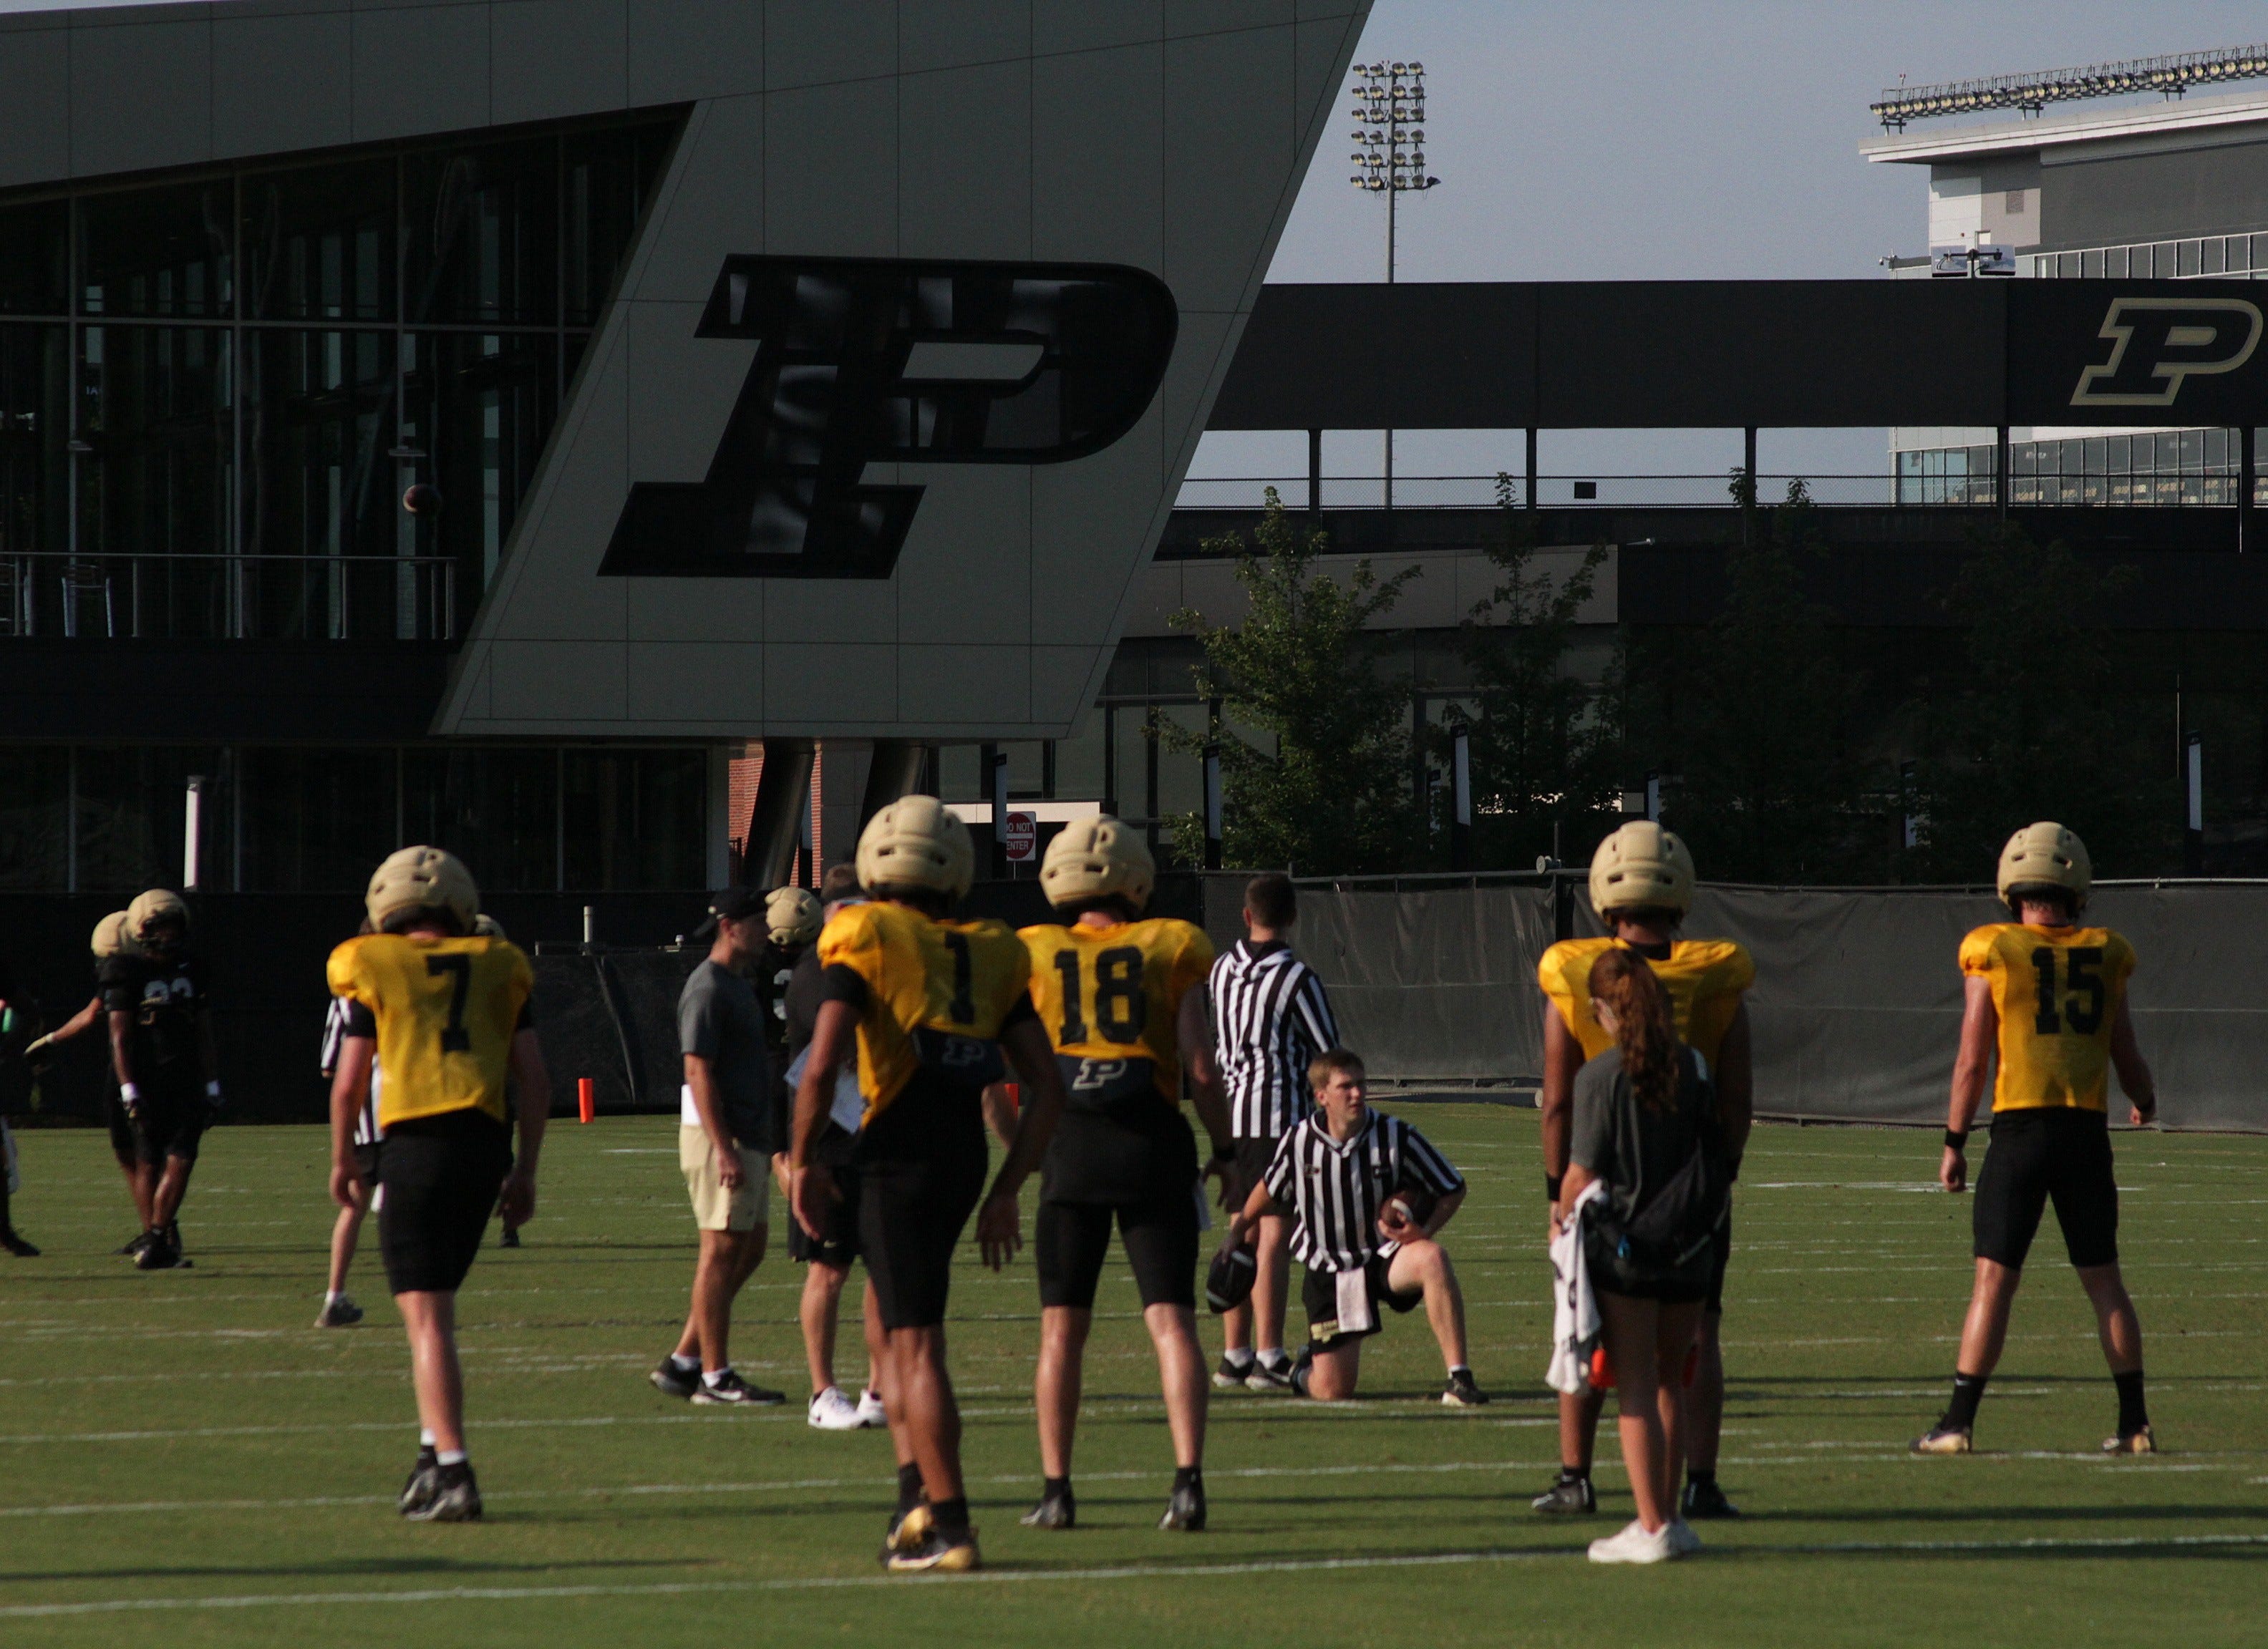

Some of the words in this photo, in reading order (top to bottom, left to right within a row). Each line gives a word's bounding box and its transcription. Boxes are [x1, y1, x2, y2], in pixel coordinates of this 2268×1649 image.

[2069, 297, 2264, 406] P
[596, 253, 1179, 580] P
[1017, 822, 1030, 832] NOT
[427, 953, 471, 1052] 7
[945, 931, 974, 1024] 1
[1054, 945, 1145, 1044] 18
[2032, 946, 2105, 1035] 15
[1072, 1057, 1128, 1091] P
